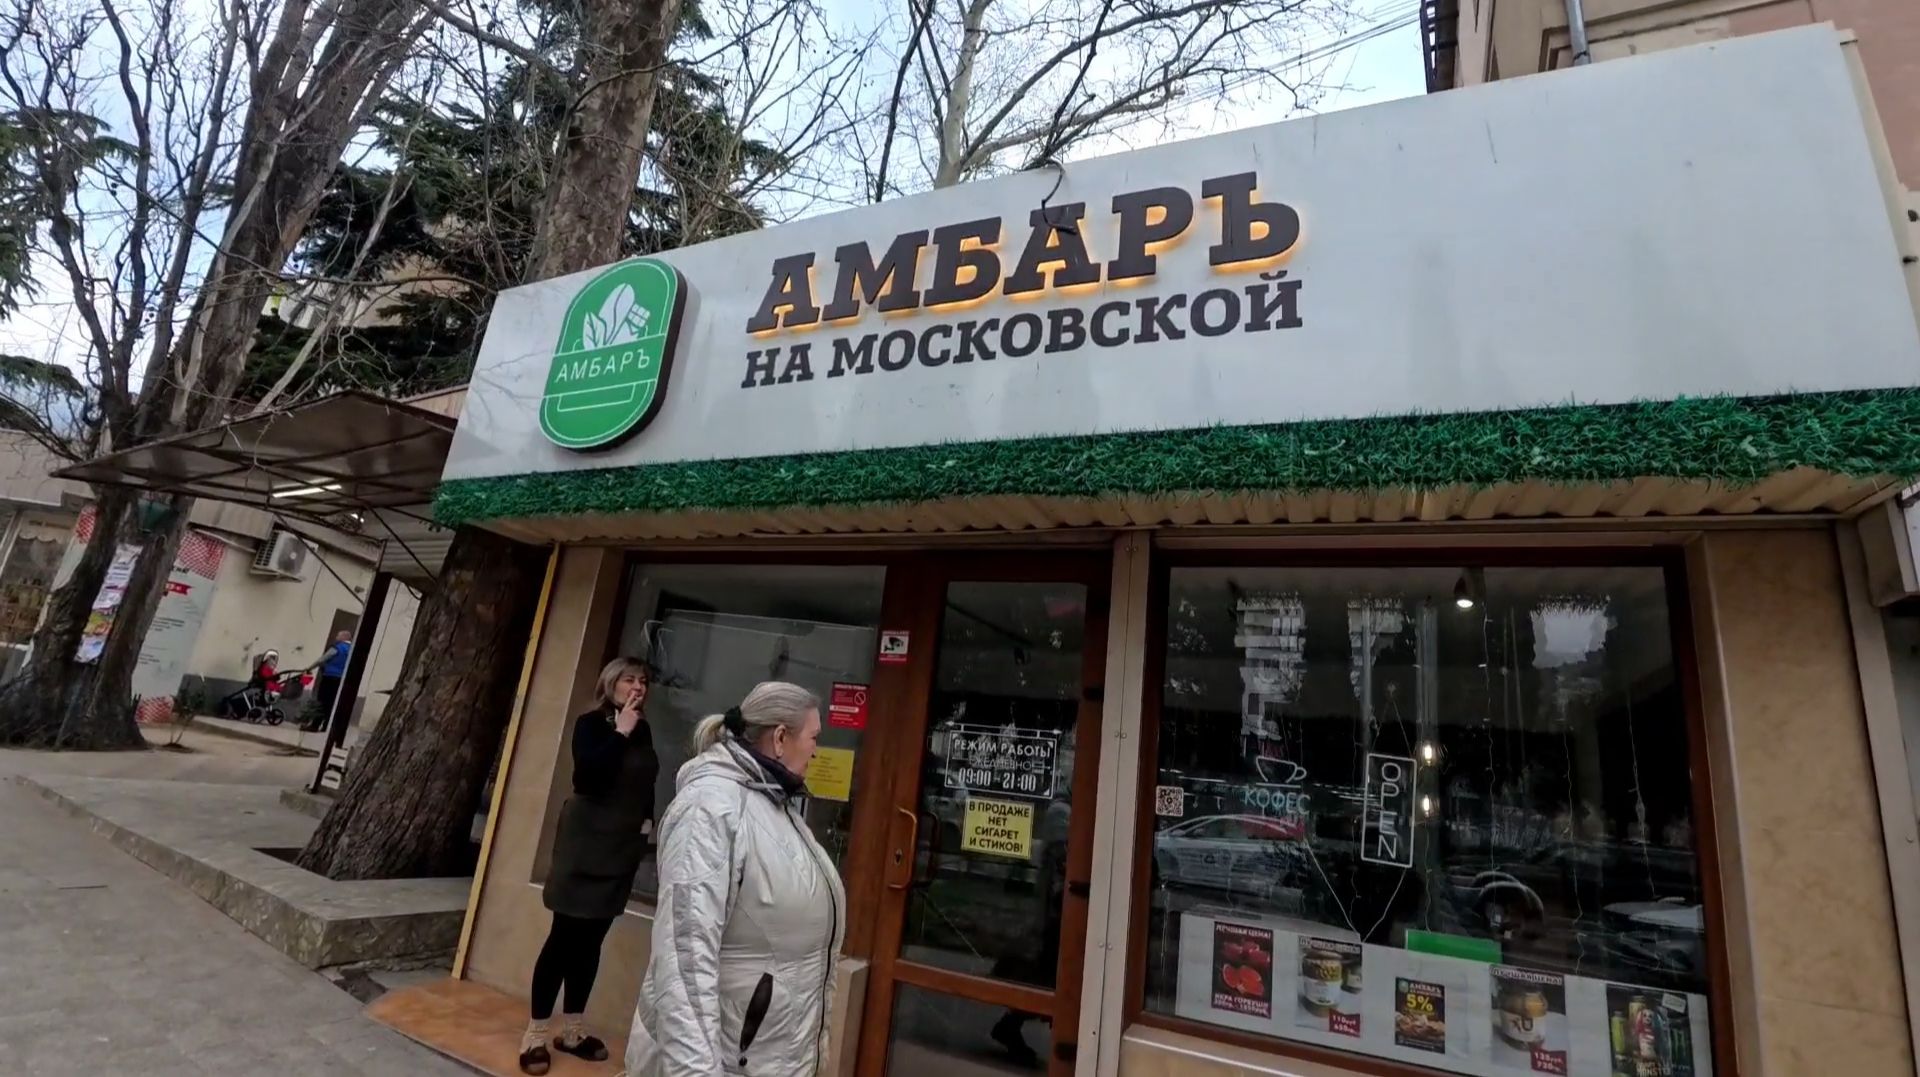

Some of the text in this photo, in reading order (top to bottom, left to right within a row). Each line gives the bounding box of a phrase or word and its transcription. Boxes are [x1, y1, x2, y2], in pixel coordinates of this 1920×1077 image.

[745, 171, 1301, 335] АМБАРЪ
[741, 270, 1303, 389] НА МОСКОВСКОЙ
[554, 348, 650, 384] АМБАРЪ
[954, 739, 1050, 758] РЕЖИМ РАБОТЫ
[958, 767, 991, 787] 09:00
[1002, 772, 1036, 792] 21:00
[968, 801, 1030, 818] В ПРОДАЖЕ
[1376, 761, 1402, 860] OPEN
[988, 816, 1008, 827] НЕТ
[974, 826, 1019, 840] СИГАРЕТ
[969, 837, 1023, 854] И СТИКОВ!
[1406, 993, 1434, 1012] 5%
